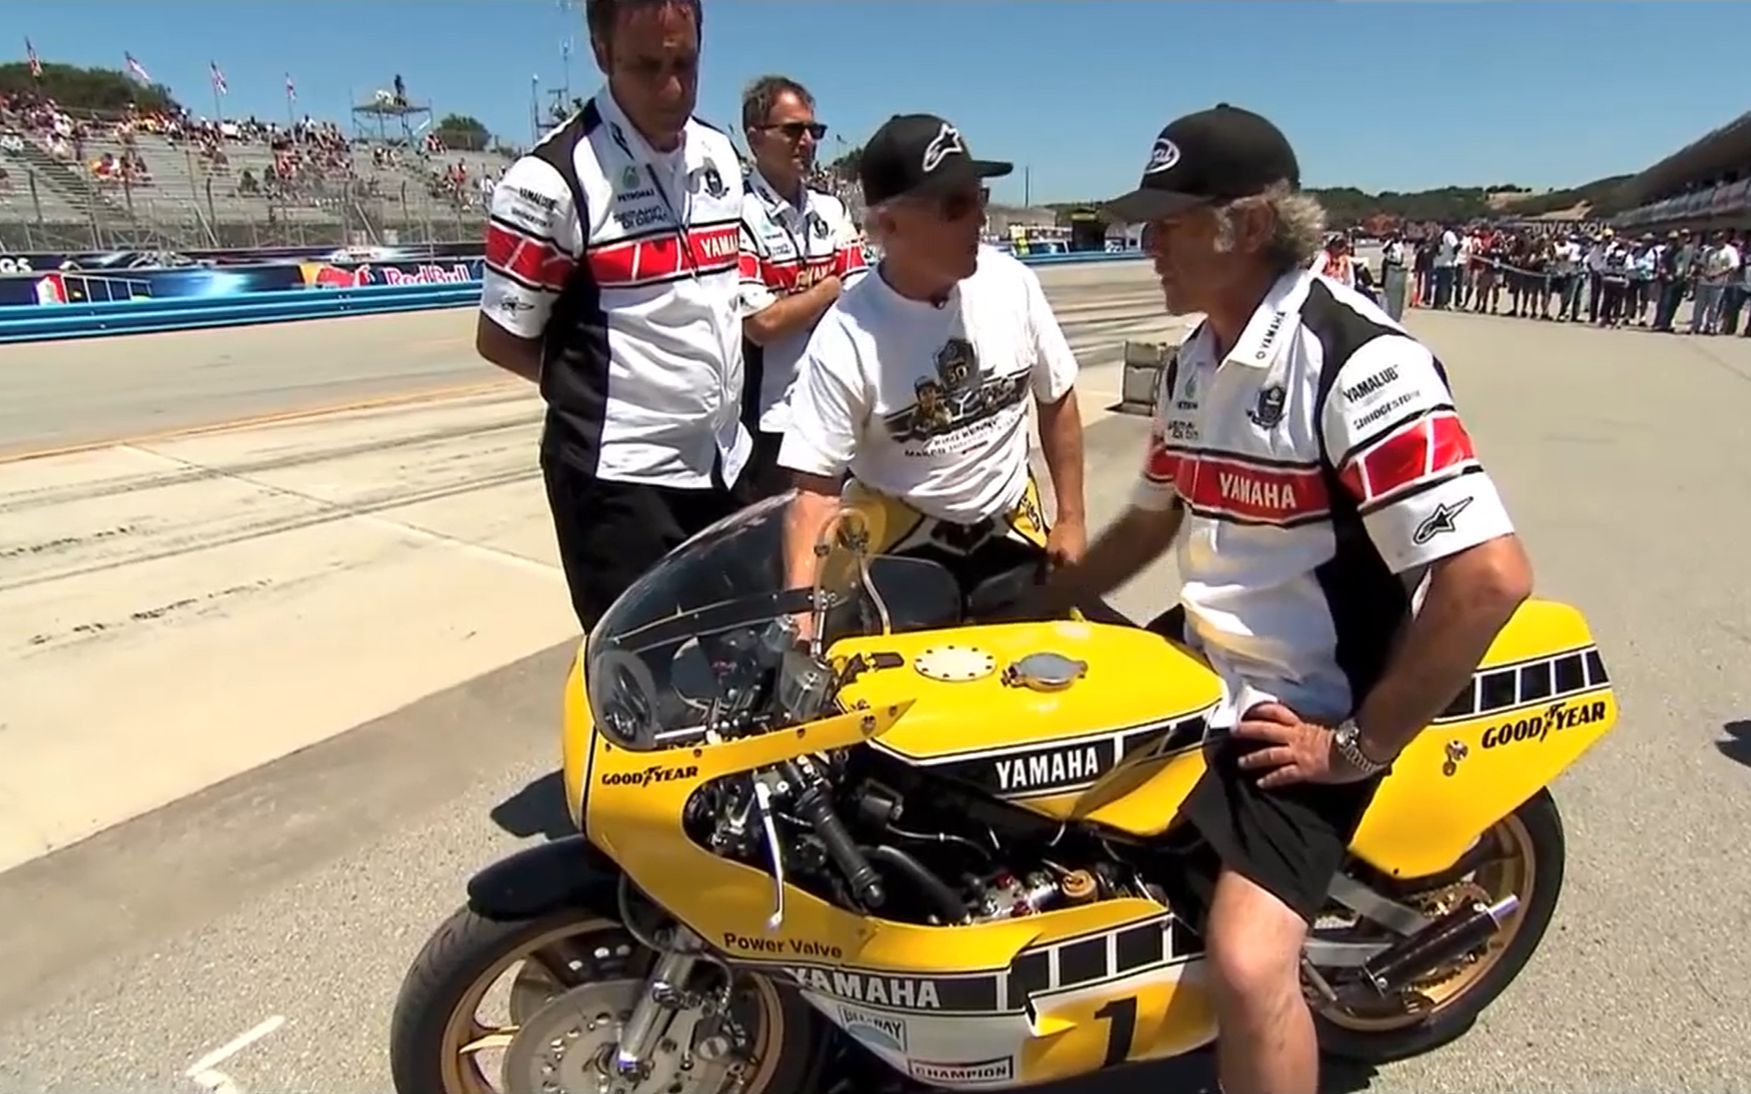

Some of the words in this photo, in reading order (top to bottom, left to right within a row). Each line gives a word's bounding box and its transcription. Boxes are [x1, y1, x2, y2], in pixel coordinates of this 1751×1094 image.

[1260, 311, 1286, 349] YAMAHA
[1219, 472, 1297, 509] YAMAHA
[1481, 702, 1606, 749] GOODYEAR
[601, 765, 698, 788] GOODYEAR
[995, 746, 1099, 789] YAMAHA
[723, 932, 785, 953] Power
[789, 938, 843, 958] Valve
[784, 966, 941, 1008] YAMAHA
[1094, 996, 1137, 1069] 1
[914, 1065, 1007, 1079] CHAMPION
